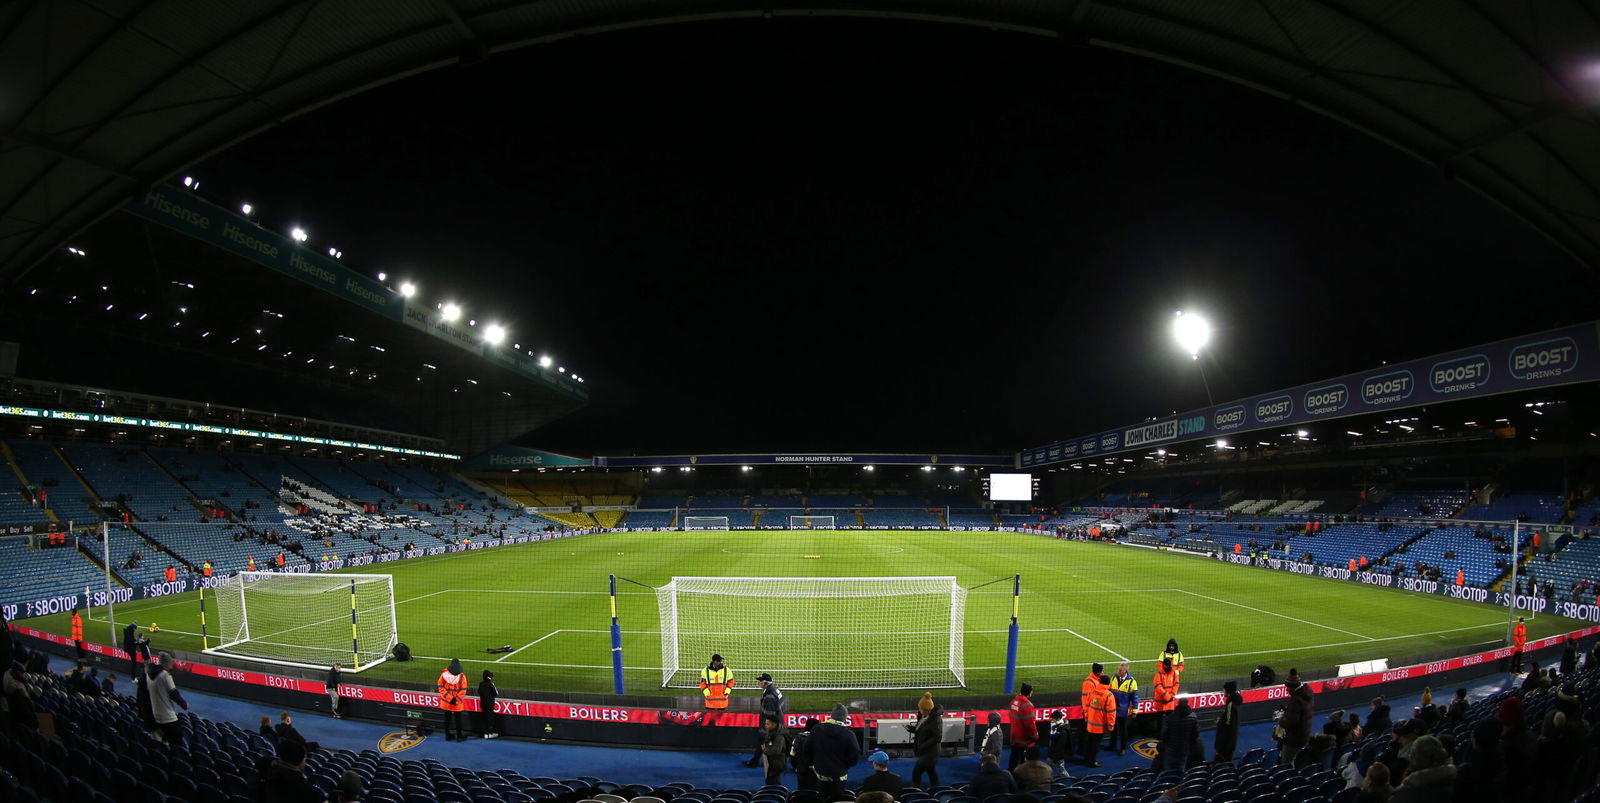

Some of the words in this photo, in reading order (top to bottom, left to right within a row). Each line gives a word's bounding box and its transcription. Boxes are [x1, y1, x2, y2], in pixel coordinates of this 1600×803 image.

[144, 192, 209, 230] Hisense
[223, 223, 279, 258] Hisense
[289, 253, 337, 285] Hisense
[345, 279, 386, 306] Hisense
[407, 308, 426, 323] JACK
[461, 333, 481, 349] STA
[1515, 346, 1572, 370] BOOST
[1435, 363, 1485, 384] BOOST
[1526, 368, 1562, 380] DRINKS
[1366, 377, 1409, 397] BOOST
[1444, 382, 1476, 393] DRINKS
[1307, 390, 1345, 408] BOOST
[1373, 394, 1402, 405] DRINKS
[1258, 401, 1290, 416] BOOST
[1314, 405, 1338, 415] DRINKS
[53, 410, 90, 421] bet365.com
[103, 415, 138, 425] bet365.com
[1216, 410, 1243, 424] BOOST
[1263, 415, 1284, 423] DRINKS
[150, 420, 182, 429] bet365.com
[192, 424, 222, 433] bet365.com
[1126, 430, 1144, 444] JOHN
[1144, 422, 1175, 441] CHARLES
[1178, 415, 1205, 435] STAND
[232, 428, 259, 437] bet365.com
[1102, 436, 1118, 446] BOOST
[490, 454, 543, 465] Hisense
[380, 551, 400, 562] SBOTOP
[406, 548, 424, 559] SBOTOP
[1230, 554, 1251, 565] SBOTOP
[320, 559, 344, 572] SBOTOP
[351, 555, 374, 566] SBOTOP
[1289, 562, 1314, 575] SBOTOP
[1323, 568, 1351, 580] SBOTOP
[1361, 571, 1392, 587] SBOTOP
[150, 580, 187, 598] SBOTOP
[1403, 578, 1438, 594] SBOTOP
[94, 587, 133, 607] SBOTOP
[1450, 585, 1488, 603] SBOTOP
[36, 595, 78, 616] SBOTOP
[1563, 602, 1600, 623] SBOTO
[87, 643, 103, 653] BOILERS
[1494, 649, 1511, 659] BOILERS
[1462, 655, 1482, 666] BOILERS
[217, 668, 245, 681] BOILERS
[1382, 669, 1409, 682] BOILERS
[393, 692, 439, 707] BOILERS
[569, 706, 629, 721] BOILERS
